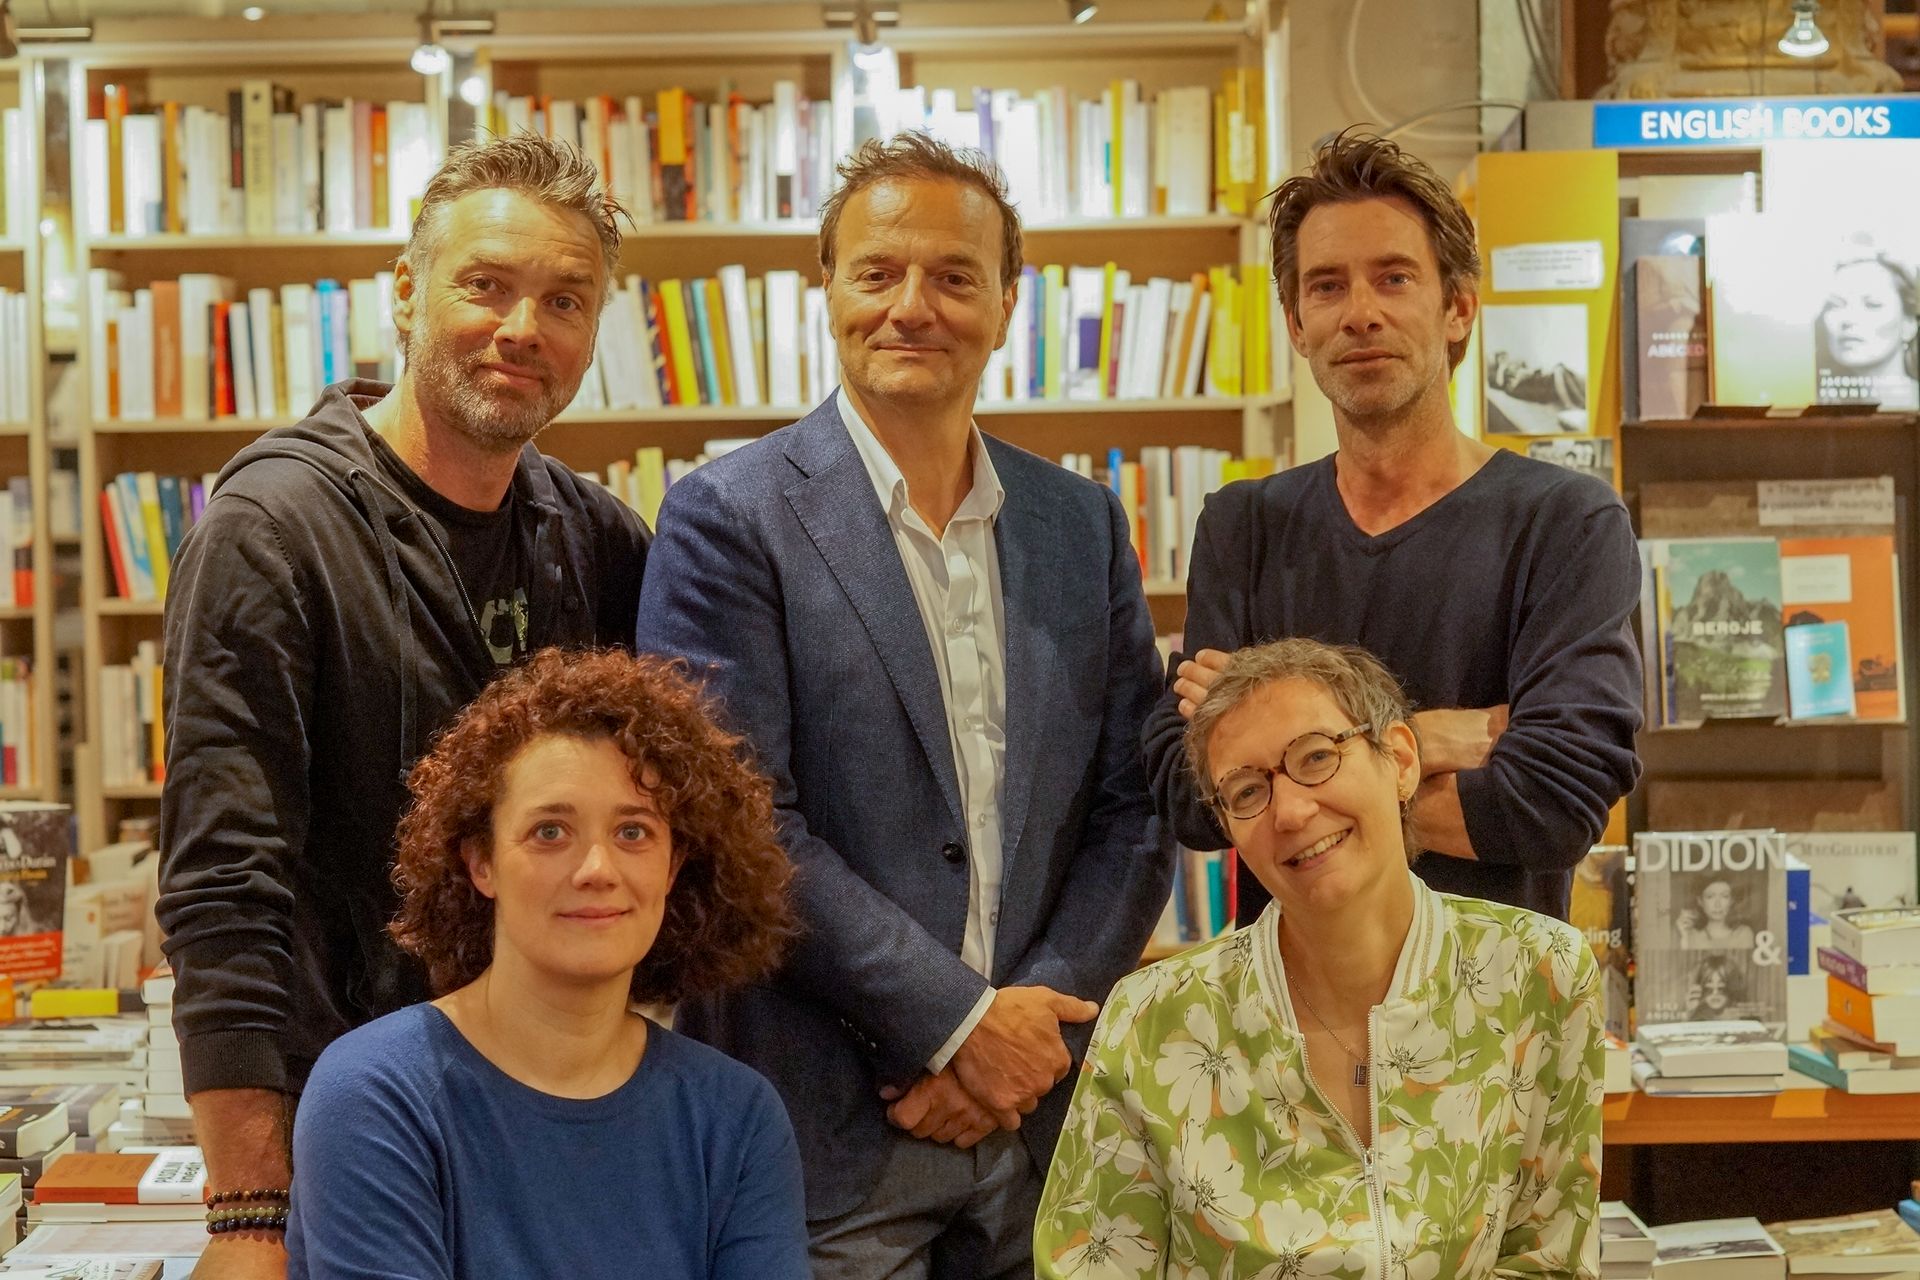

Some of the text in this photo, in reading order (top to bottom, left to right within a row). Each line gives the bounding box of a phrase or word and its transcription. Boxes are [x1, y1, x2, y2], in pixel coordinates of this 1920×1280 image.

[1641, 106, 1891, 139] ENGLISH BOOKS
[1638, 835, 1786, 872] DIDION
[1752, 930, 1782, 966] &
